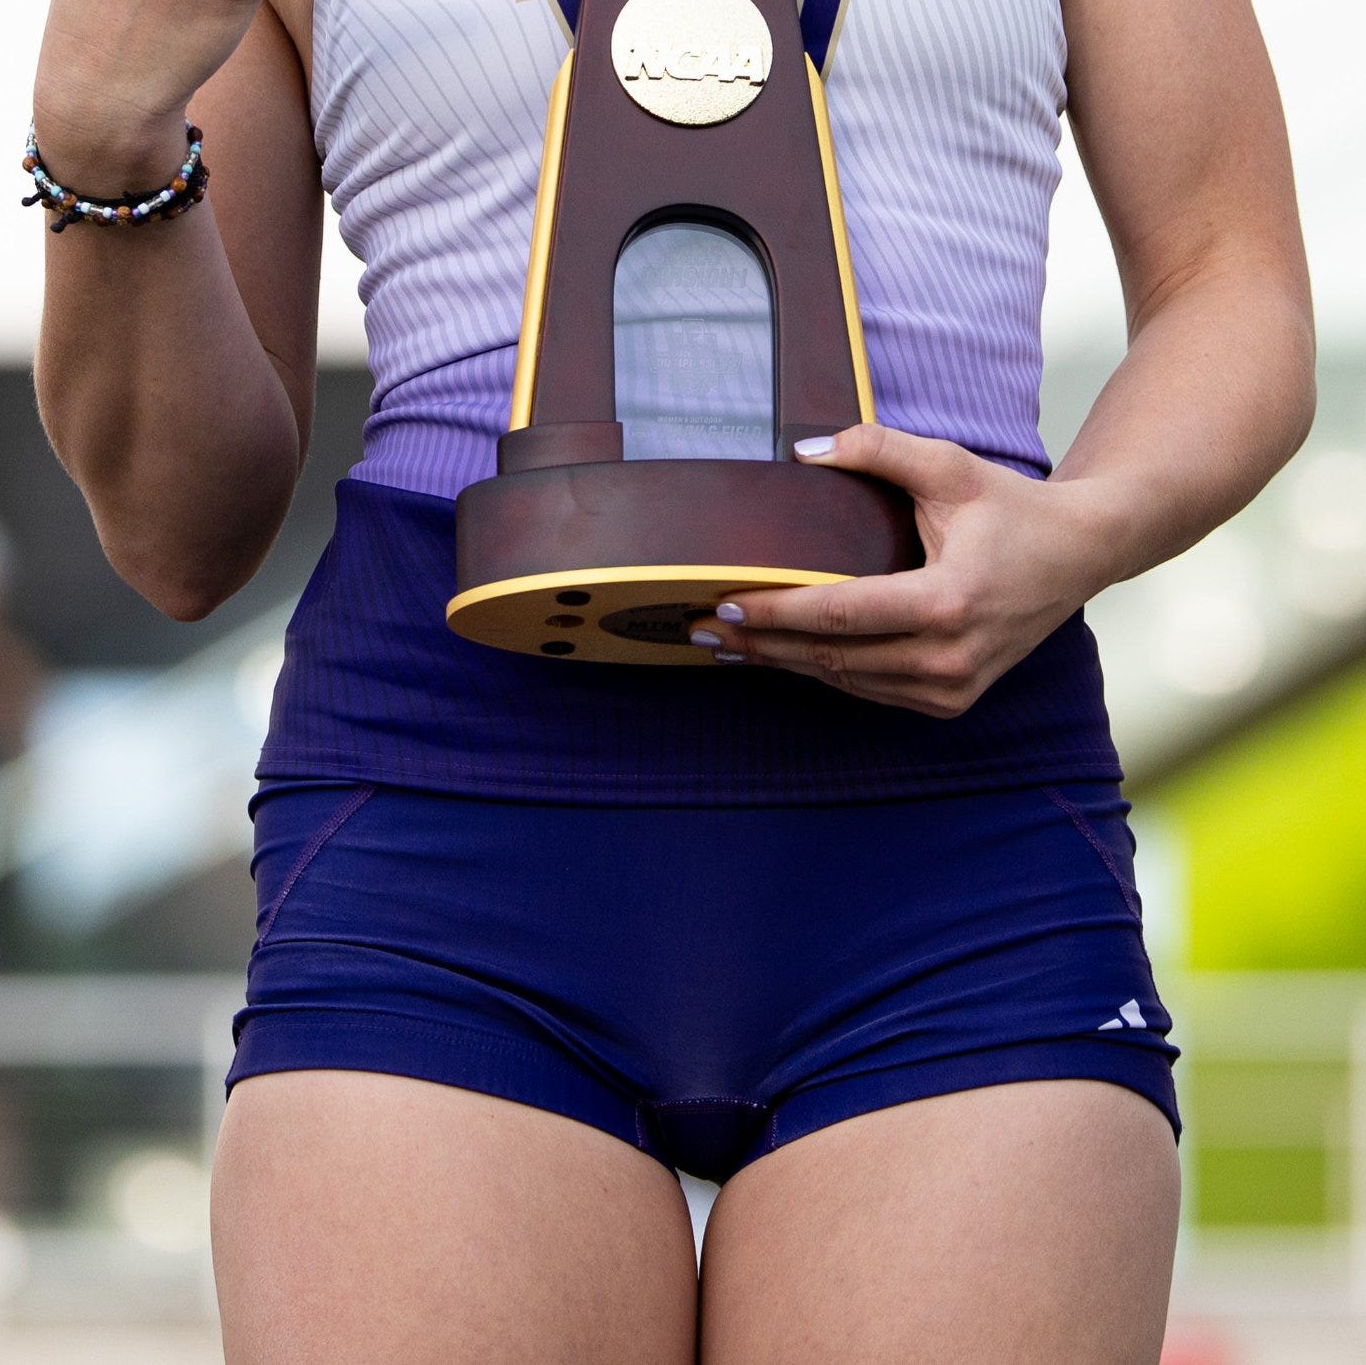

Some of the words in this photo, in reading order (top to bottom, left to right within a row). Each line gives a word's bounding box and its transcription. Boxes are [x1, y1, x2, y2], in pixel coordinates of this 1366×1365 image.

[623, 46, 765, 87] NCAA
[662, 424, 705, 440] ACK
[721, 425, 762, 440] FIELD
